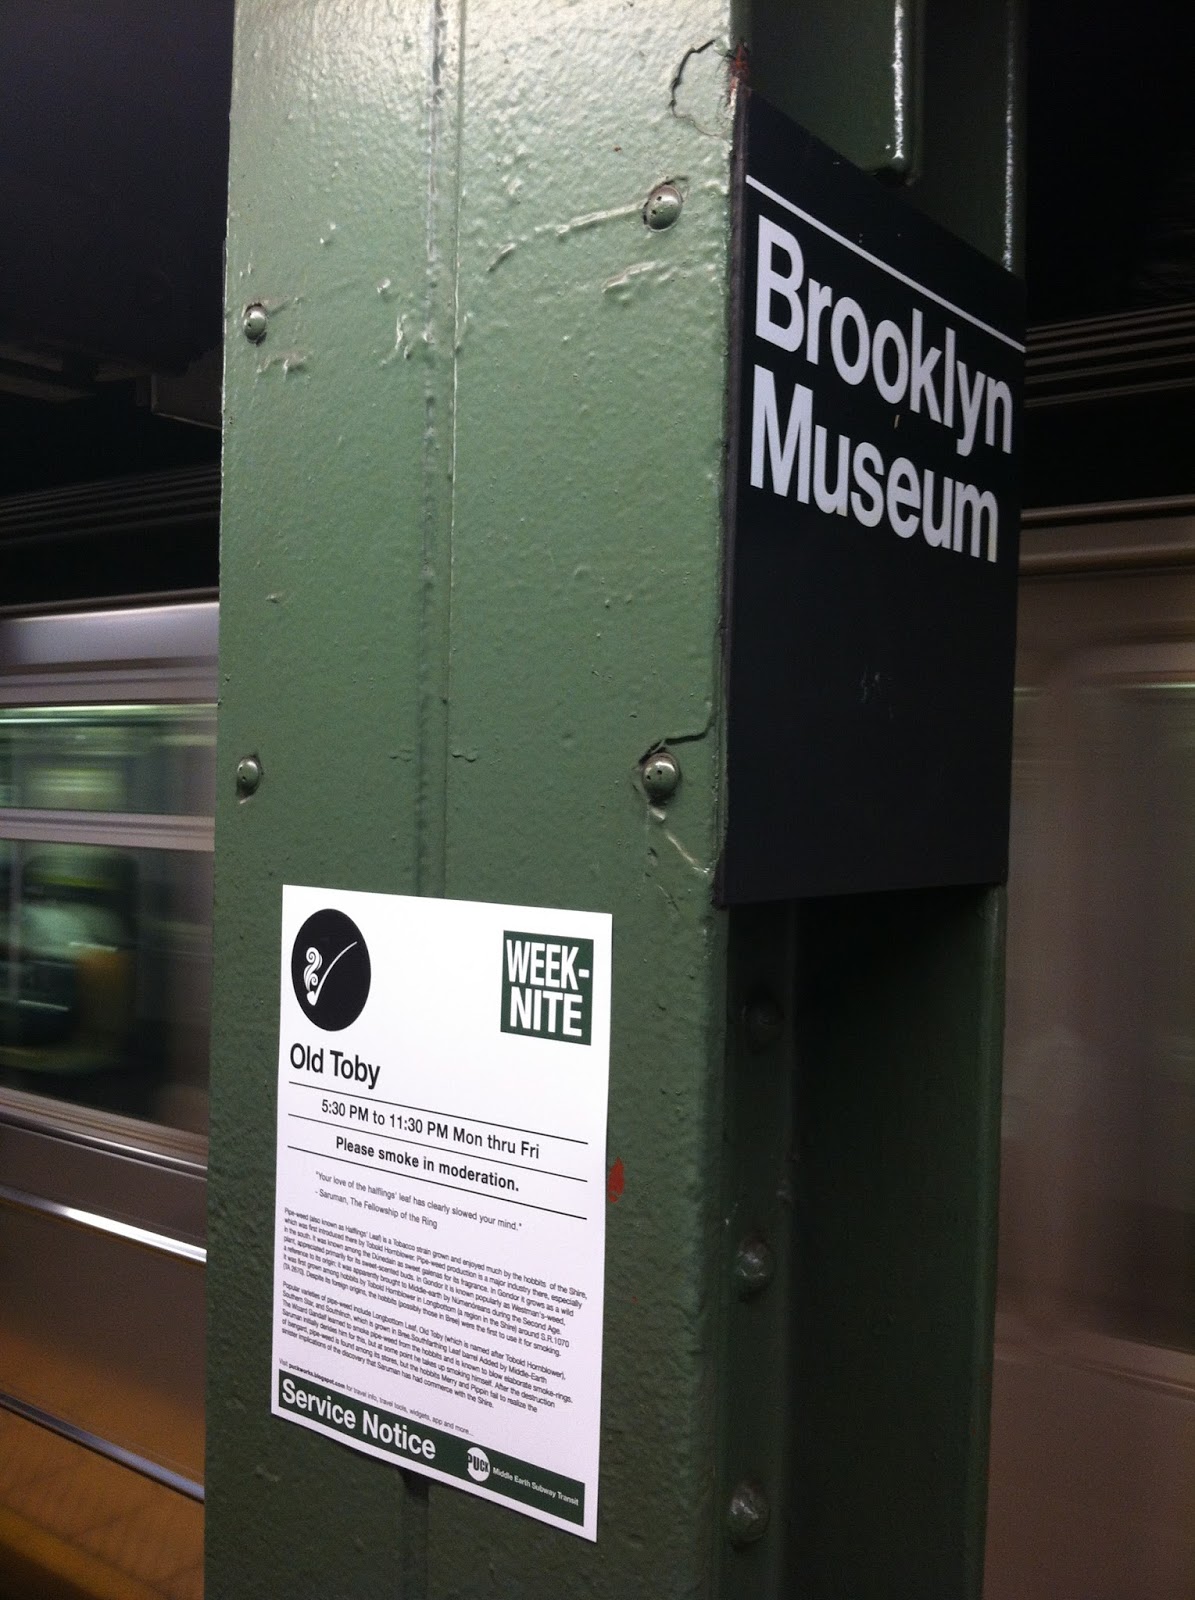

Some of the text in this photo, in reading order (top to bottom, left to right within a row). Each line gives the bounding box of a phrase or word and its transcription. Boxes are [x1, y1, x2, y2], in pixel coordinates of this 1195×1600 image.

[755, 215, 1012, 457] Brooklyn
[750, 364, 998, 563] Museum
[506, 939, 589, 990] WEEK-
[510, 986, 583, 1037] NITE
[290, 1043, 380, 1090] Old Toby
[321, 1099, 539, 1158] 5:30 PM to 11:30 PM Mon thru Fri
[336, 1136, 518, 1191] Please smoke in moderation.
[319, 1188, 348, 1205] Saruman,
[350, 1196, 362, 1207] The
[363, 1200, 398, 1218] Fellowship
[409, 1213, 420, 1223] the
[421, 1215, 437, 1229] Ring
[333, 1176, 346, 1186] love
[348, 1180, 354, 1188] of
[355, 1182, 366, 1191] the
[399, 1192, 411, 1203] leaf
[413, 1196, 425, 1207] has
[427, 1200, 450, 1214] clearly
[452, 1207, 477, 1220] slowed
[479, 1215, 496, 1224] your
[282, 1378, 436, 1460] Service Notice
[467, 1453, 489, 1472] PUCK
[493, 1467, 579, 1506] Middle Earth Subway Transit
